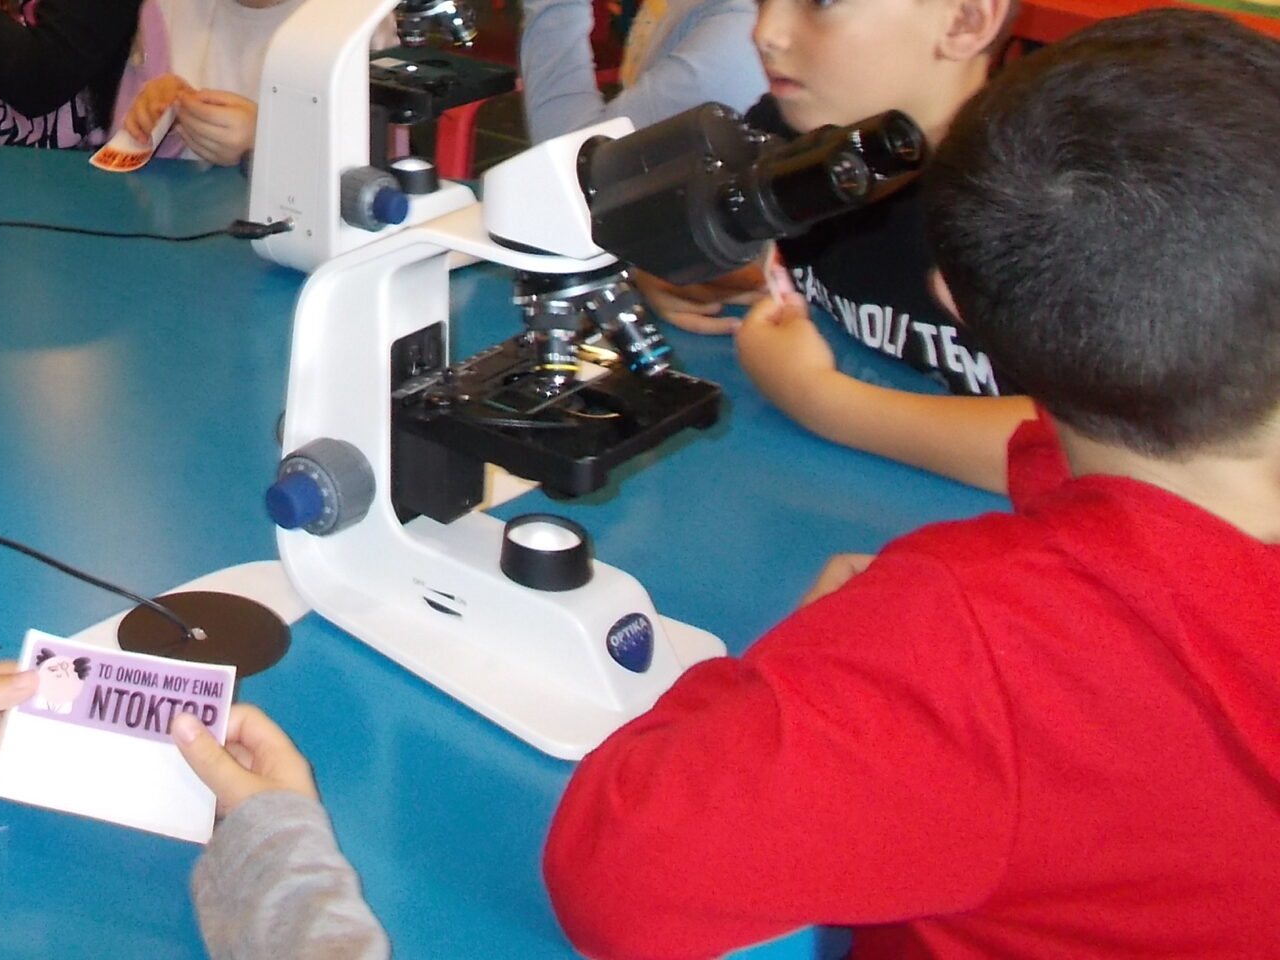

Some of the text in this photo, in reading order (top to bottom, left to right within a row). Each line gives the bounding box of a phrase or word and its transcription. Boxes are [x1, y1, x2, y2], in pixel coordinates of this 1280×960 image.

[610, 617, 649, 647] OPTIKA
[99, 663, 224, 699] ΤΟ ΟΝΟΜΑ ΜΟΥ ΕΙΝΑΙ
